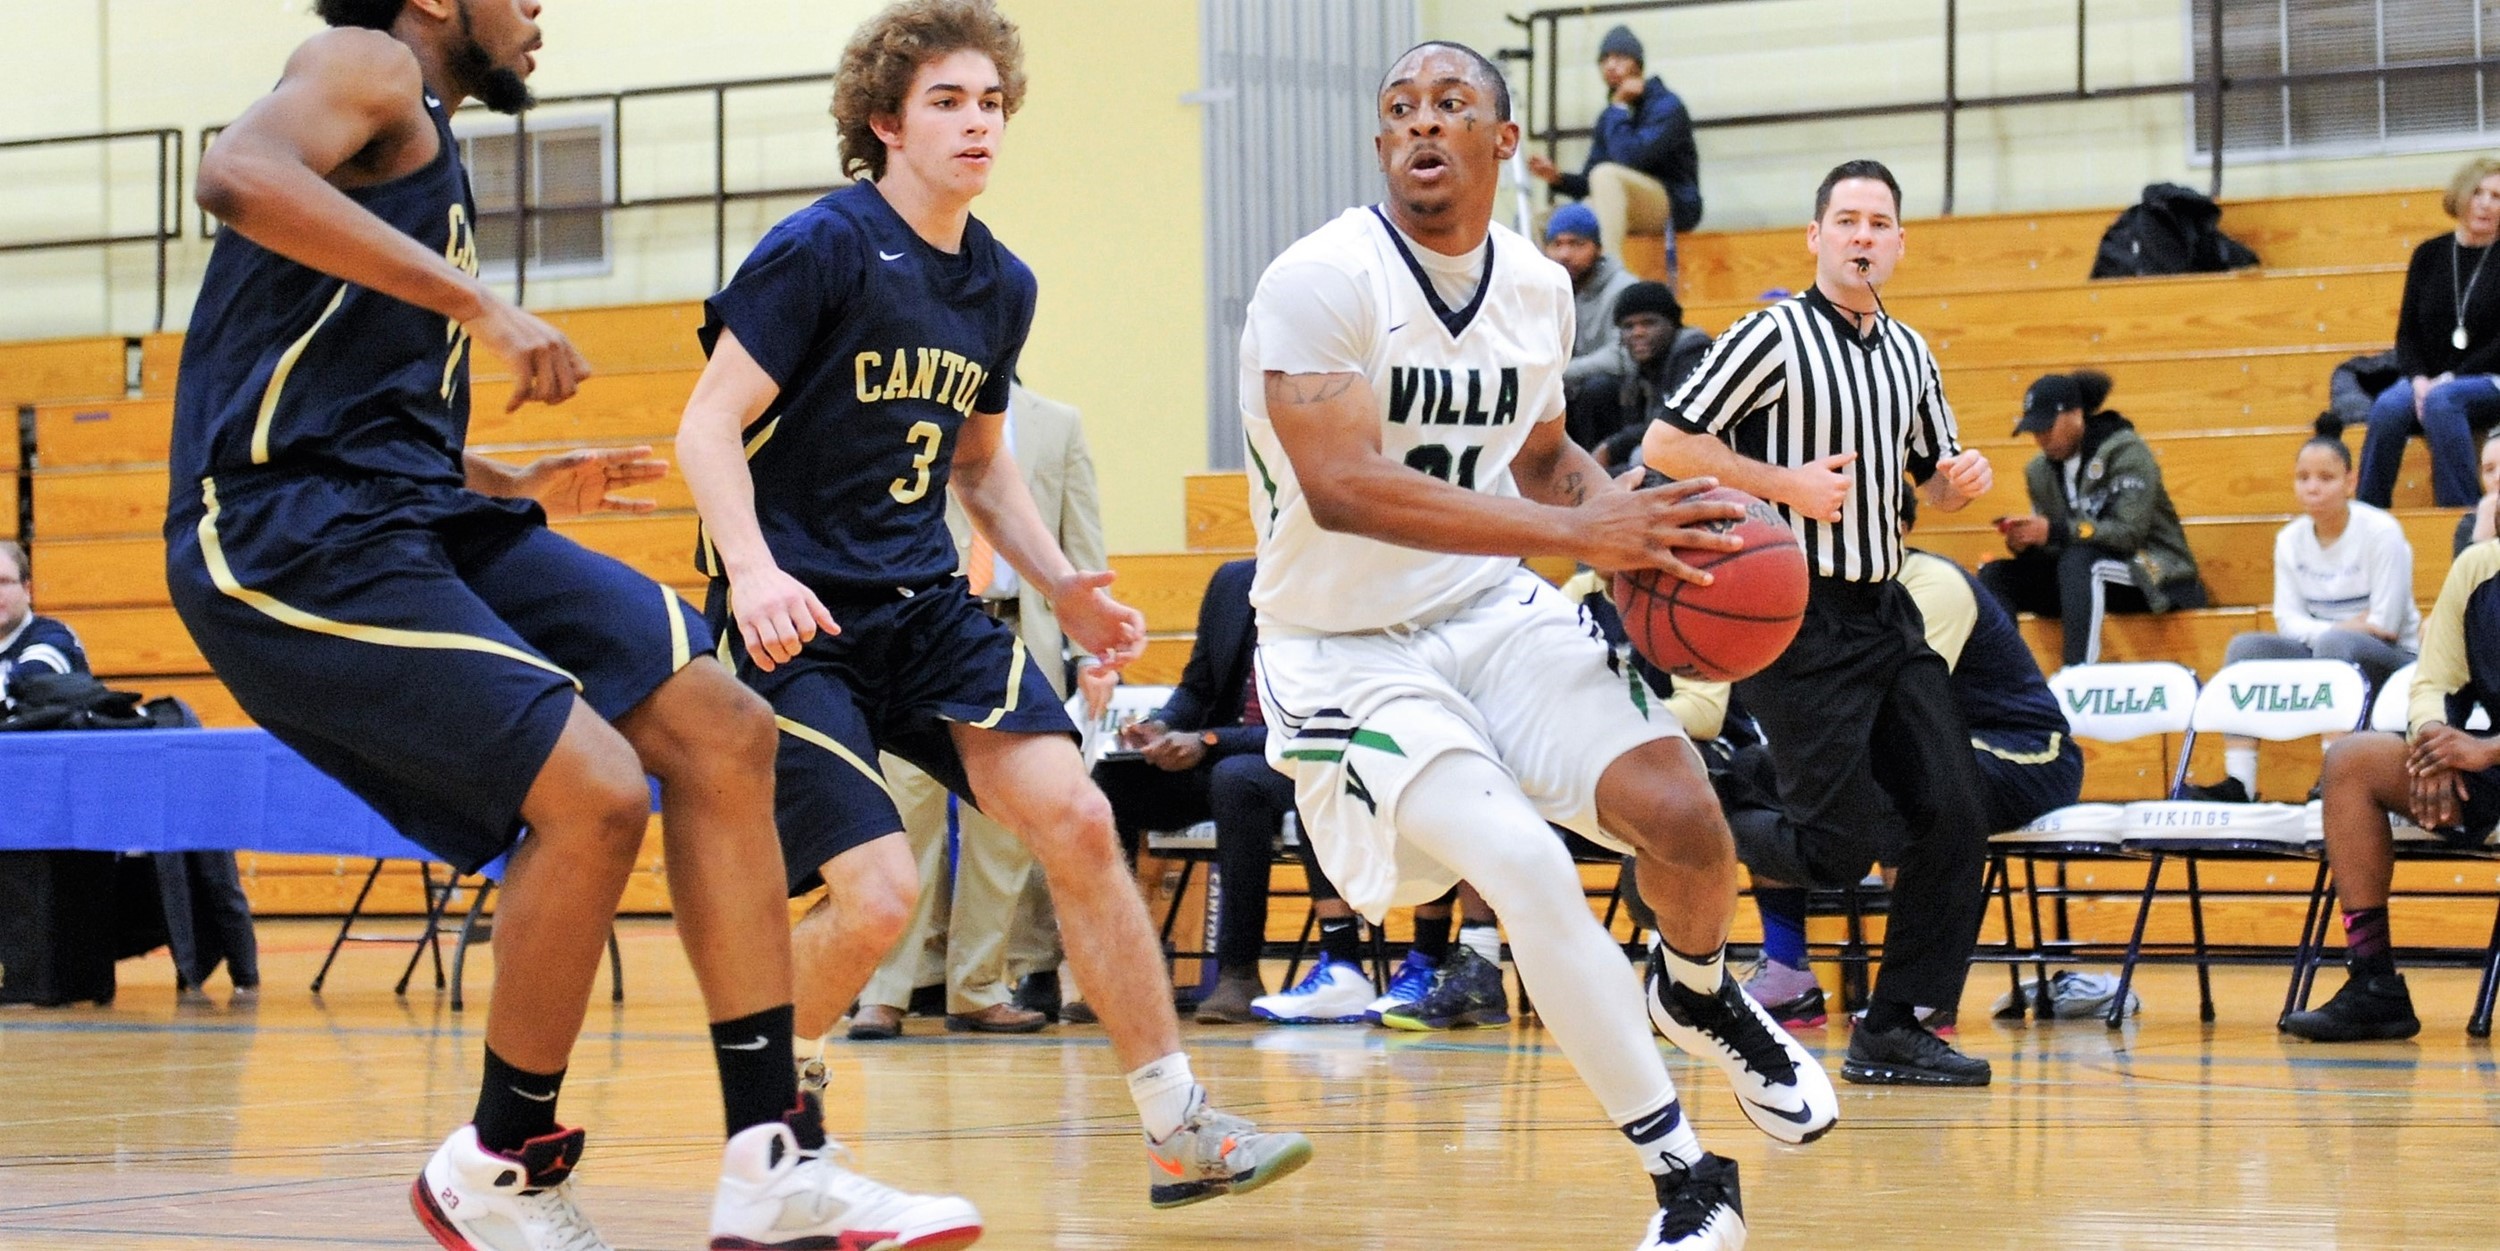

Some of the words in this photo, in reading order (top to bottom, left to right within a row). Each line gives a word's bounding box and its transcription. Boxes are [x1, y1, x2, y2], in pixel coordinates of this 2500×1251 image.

[855, 347, 989, 418] CANTO
[1388, 366, 1519, 426] VILLA
[889, 421, 942, 504] 3
[2066, 685, 2168, 715] VILLA
[2229, 683, 2334, 712] VILLA
[2143, 811, 2230, 826] VIKINGS
[1206, 872, 1221, 953] CANTON
[441, 1187, 459, 1209] 23
